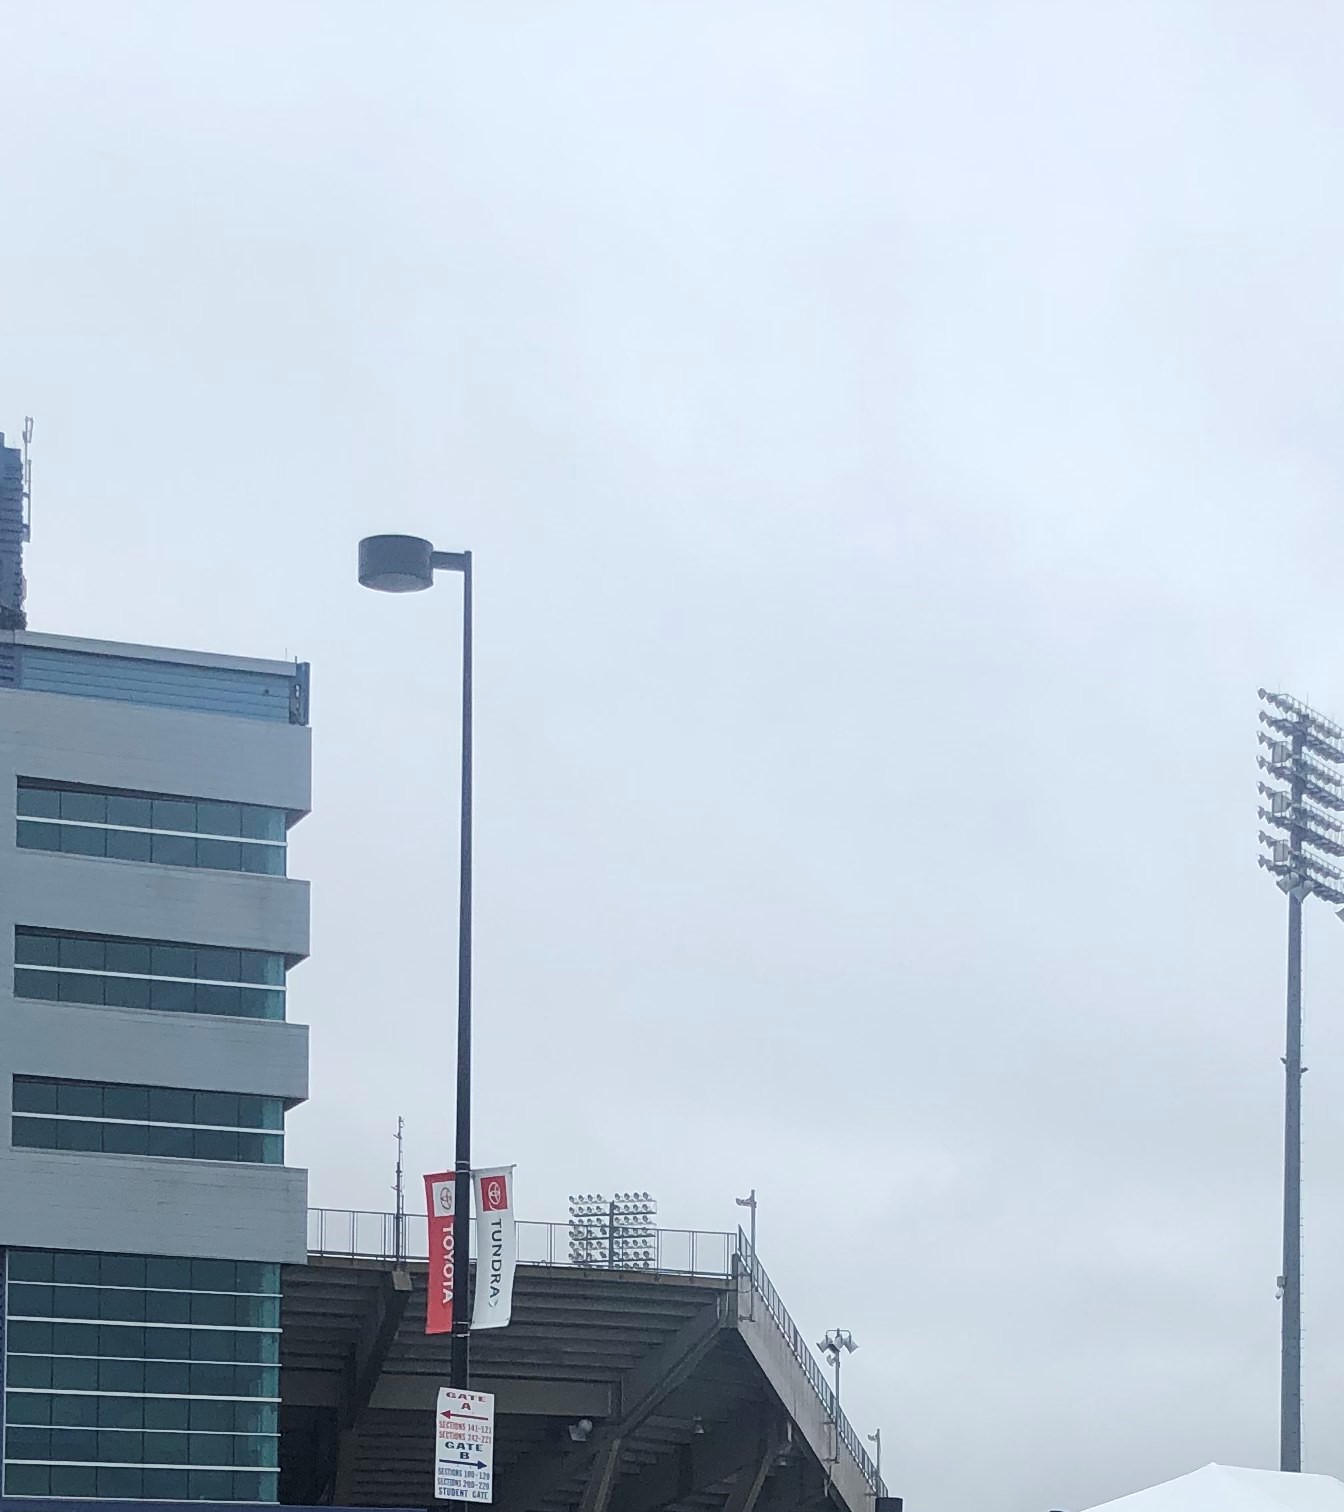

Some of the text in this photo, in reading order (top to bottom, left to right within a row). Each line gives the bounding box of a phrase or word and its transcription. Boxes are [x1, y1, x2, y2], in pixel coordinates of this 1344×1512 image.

[443, 1223, 454, 1304] TOYOTA
[490, 1218, 502, 1299] TUNDRA
[446, 1392, 487, 1402] GATE
[439, 1420, 465, 1432] SECTIONS
[439, 1430, 465, 1441] SECTIONS
[445, 1441, 483, 1452] GATE
[460, 1452, 470, 1460] B
[438, 1467, 462, 1478] SECTIONS
[438, 1487, 488, 1500] STUDENT GATE
